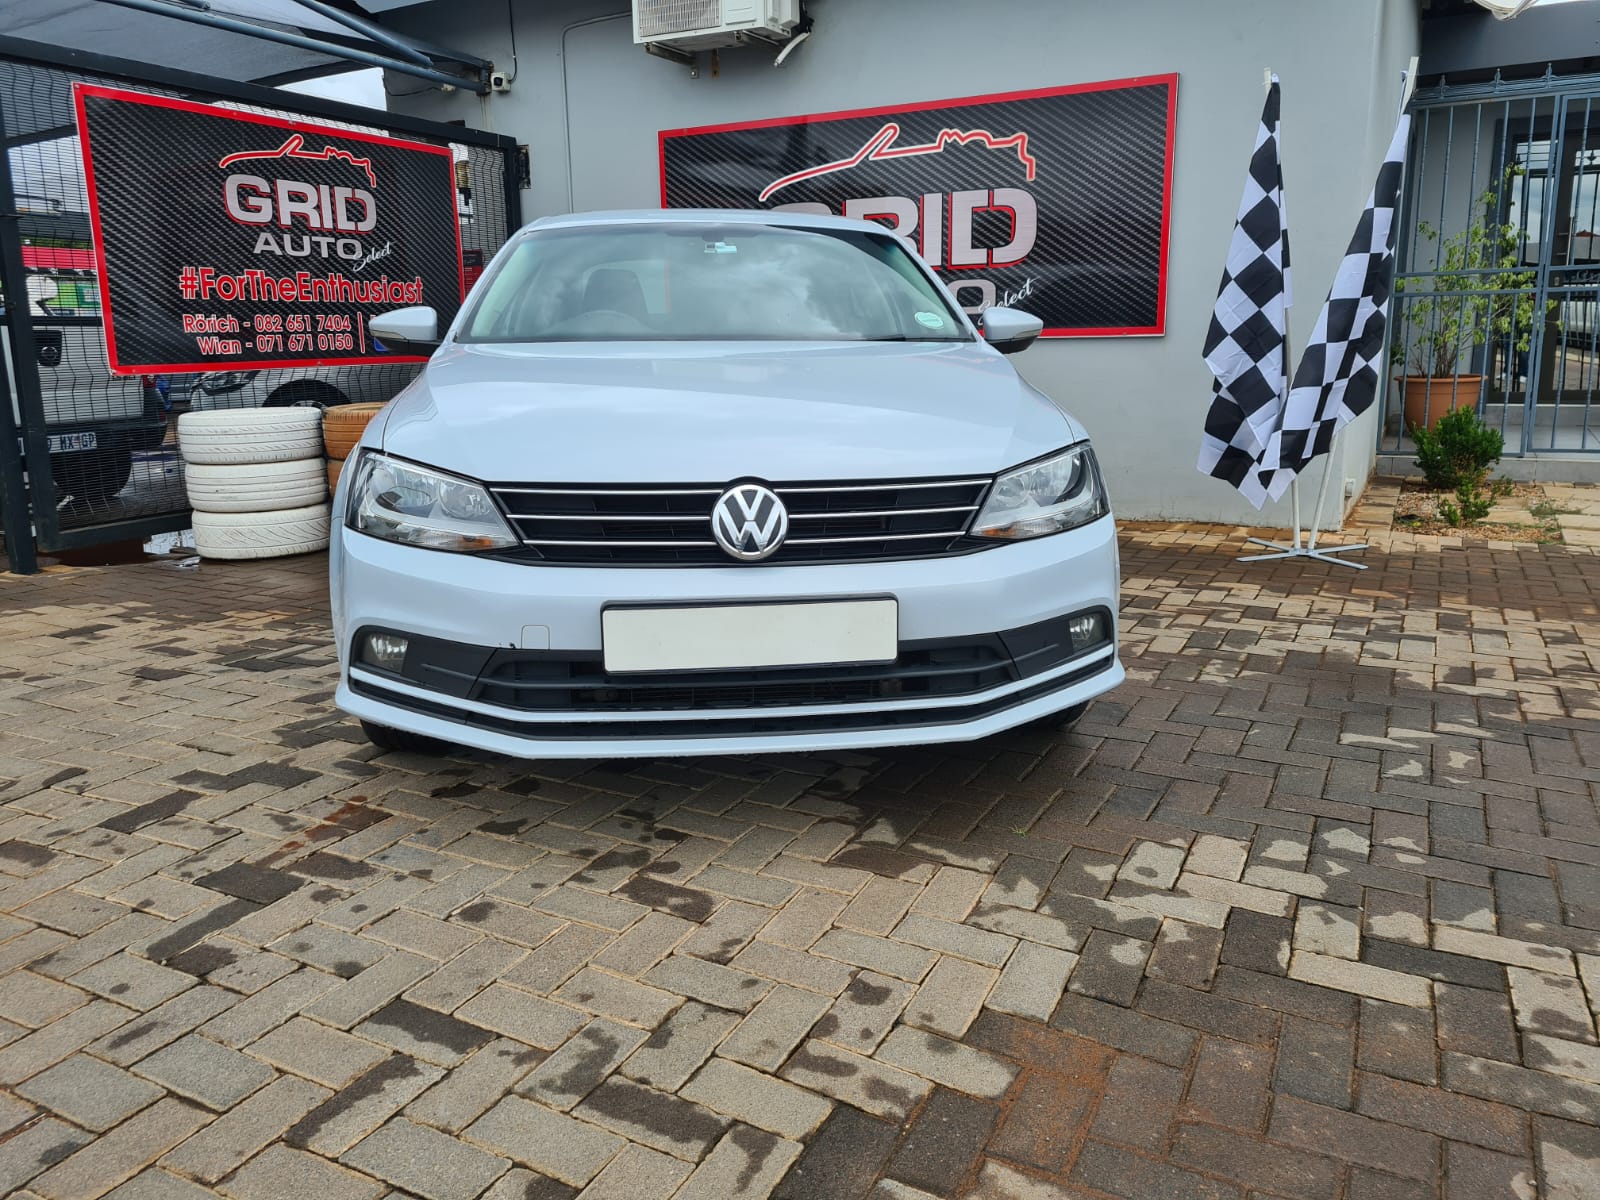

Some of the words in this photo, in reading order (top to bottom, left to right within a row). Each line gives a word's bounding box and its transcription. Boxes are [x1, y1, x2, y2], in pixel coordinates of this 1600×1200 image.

[223, 174, 377, 234] GRID
[770, 187, 1038, 270] RID
[253, 232, 363, 260] AUTO
[353, 241, 393, 272] Select
[179, 266, 423, 303] #ForTheEnthusiast
[182, 314, 239, 333] Rörich
[254, 315, 283, 332] 082
[286, 314, 312, 332] 651
[316, 314, 351, 332] 7404
[197, 336, 242, 355] Wian
[256, 334, 284, 352] 071
[288, 334, 314, 352] 671
[317, 333, 353, 351] 0150
